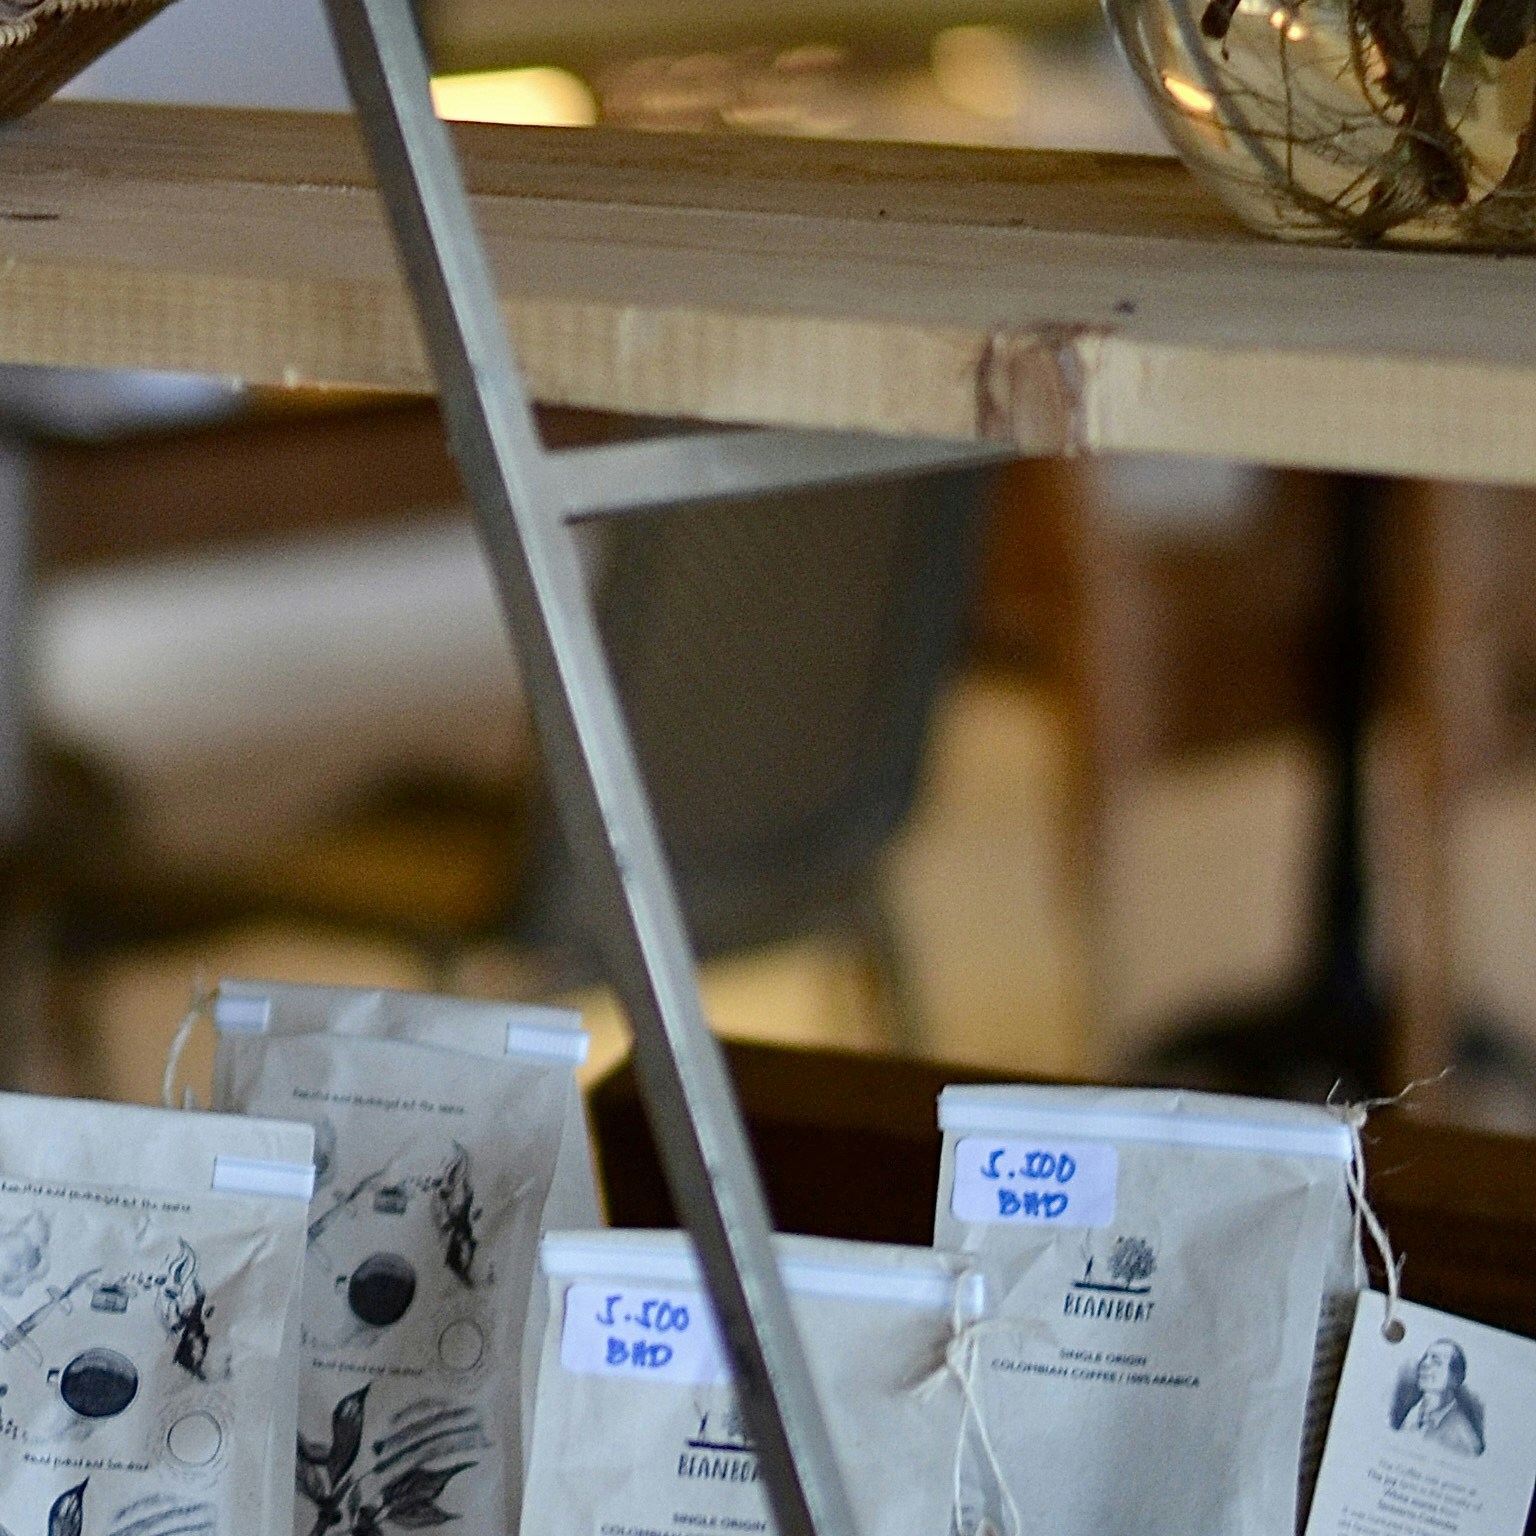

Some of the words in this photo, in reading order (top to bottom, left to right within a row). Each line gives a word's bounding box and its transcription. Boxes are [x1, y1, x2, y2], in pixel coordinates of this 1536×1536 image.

[998, 1189, 1069, 1218] BHD
[596, 1293, 691, 1332] 5.500
[606, 1336, 674, 1368] BHD
[677, 1452, 760, 1483] BEANBO
